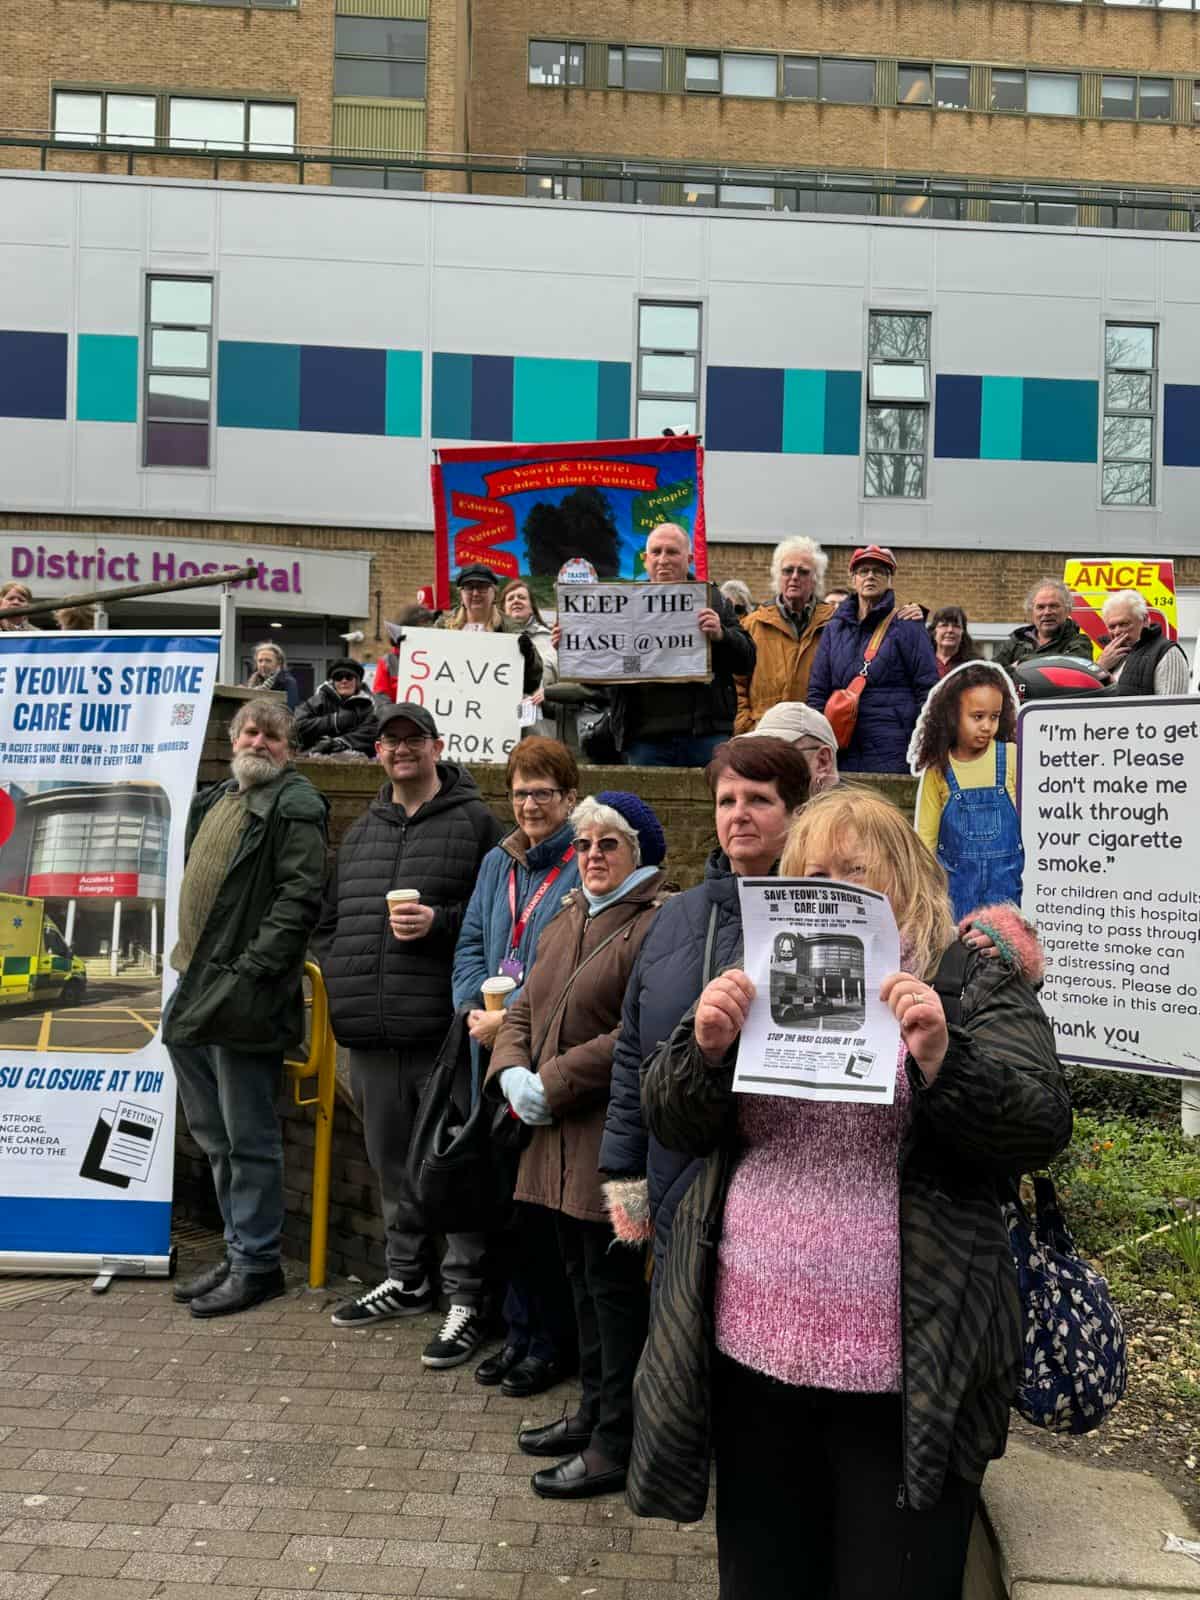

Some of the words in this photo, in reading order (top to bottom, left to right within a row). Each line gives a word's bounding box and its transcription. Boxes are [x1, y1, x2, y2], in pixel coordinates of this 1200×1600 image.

[512, 464, 554, 477] Yeovil
[559, 463, 570, 472] &
[576, 462, 630, 473] District
[498, 479, 541, 493] Trades
[545, 475, 587, 486] Union
[648, 488, 689, 508] People
[11, 546, 140, 582] District
[1065, 566, 1153, 587] ANCE
[563, 594, 628, 613] KEEP
[642, 593, 694, 612] THE
[1153, 596, 1174, 606] 134
[566, 633, 626, 651] HASU
[410, 650, 512, 686] SAVE
[15, 666, 113, 695] YEOVIL'S
[120, 665, 204, 695] STROKE
[13, 703, 73, 731] CARE
[80, 702, 132, 732] UNIT
[1083, 722, 1130, 741] here
[1136, 722, 1157, 740] to
[1163, 720, 1199, 743] get
[8, 743, 32, 753] ACUTE
[33, 743, 60, 753] STROKE
[62, 743, 80, 753] UNIT
[82, 744, 102, 754] OPEN
[110, 744, 118, 754] TO
[141, 743, 154, 753] THE
[438, 732, 517, 755] ROKE
[2, 754, 37, 765] PATIENTS
[39, 755, 56, 764] WHO
[60, 755, 79, 765] RELY
[80, 756, 92, 765] ON
[94, 756, 101, 766] IT
[1039, 750, 1105, 767] better.
[1113, 748, 1185, 767] Please
[1038, 776, 1085, 794] don't
[1093, 775, 1149, 794] make
[1156, 779, 1188, 794] me
[1038, 801, 1083, 820] walk
[1089, 802, 1169, 826] through
[1037, 831, 1081, 850] your
[1088, 830, 1183, 851] cigarette
[764, 889, 787, 900] SAVE
[789, 890, 829, 901] YEOVIL'S
[831, 892, 864, 905] STROKE
[1036, 884, 1057, 897] For
[1060, 885, 1118, 901] children
[1122, 889, 1153, 902] and
[794, 902, 816, 914] CARE
[819, 903, 839, 915] UNIT
[1035, 902, 1105, 920] attending
[1110, 905, 1136, 919] this
[1035, 918, 1083, 936] having
[1088, 921, 1103, 935] to
[1107, 926, 1143, 938] pass
[1104, 942, 1152, 957] smoke
[1157, 947, 1185, 959] can
[1058, 955, 1135, 976] distressing
[1140, 963, 1170, 976] and
[1044, 974, 1117, 989] angerous.
[1122, 977, 1172, 994] Please
[1176, 984, 1198, 997] do
[1062, 992, 1108, 1006] smoke
[1113, 995, 1126, 1008] in
[1131, 997, 1157, 1012] this
[1050, 1016, 1097, 1039] hank
[1103, 1026, 1140, 1044] you
[25, 1067, 106, 1092] CLOSURE
[107, 1070, 130, 1092] AT
[134, 1071, 165, 1093] YDH
[2, 1114, 41, 1123] STROKE
[121, 1107, 158, 1125] PETITION
[16, 1136, 60, 1145] CAMERA
[6, 1146, 28, 1155] YOU
[30, 1146, 45, 1156] TO
[47, 1147, 67, 1156] THE
